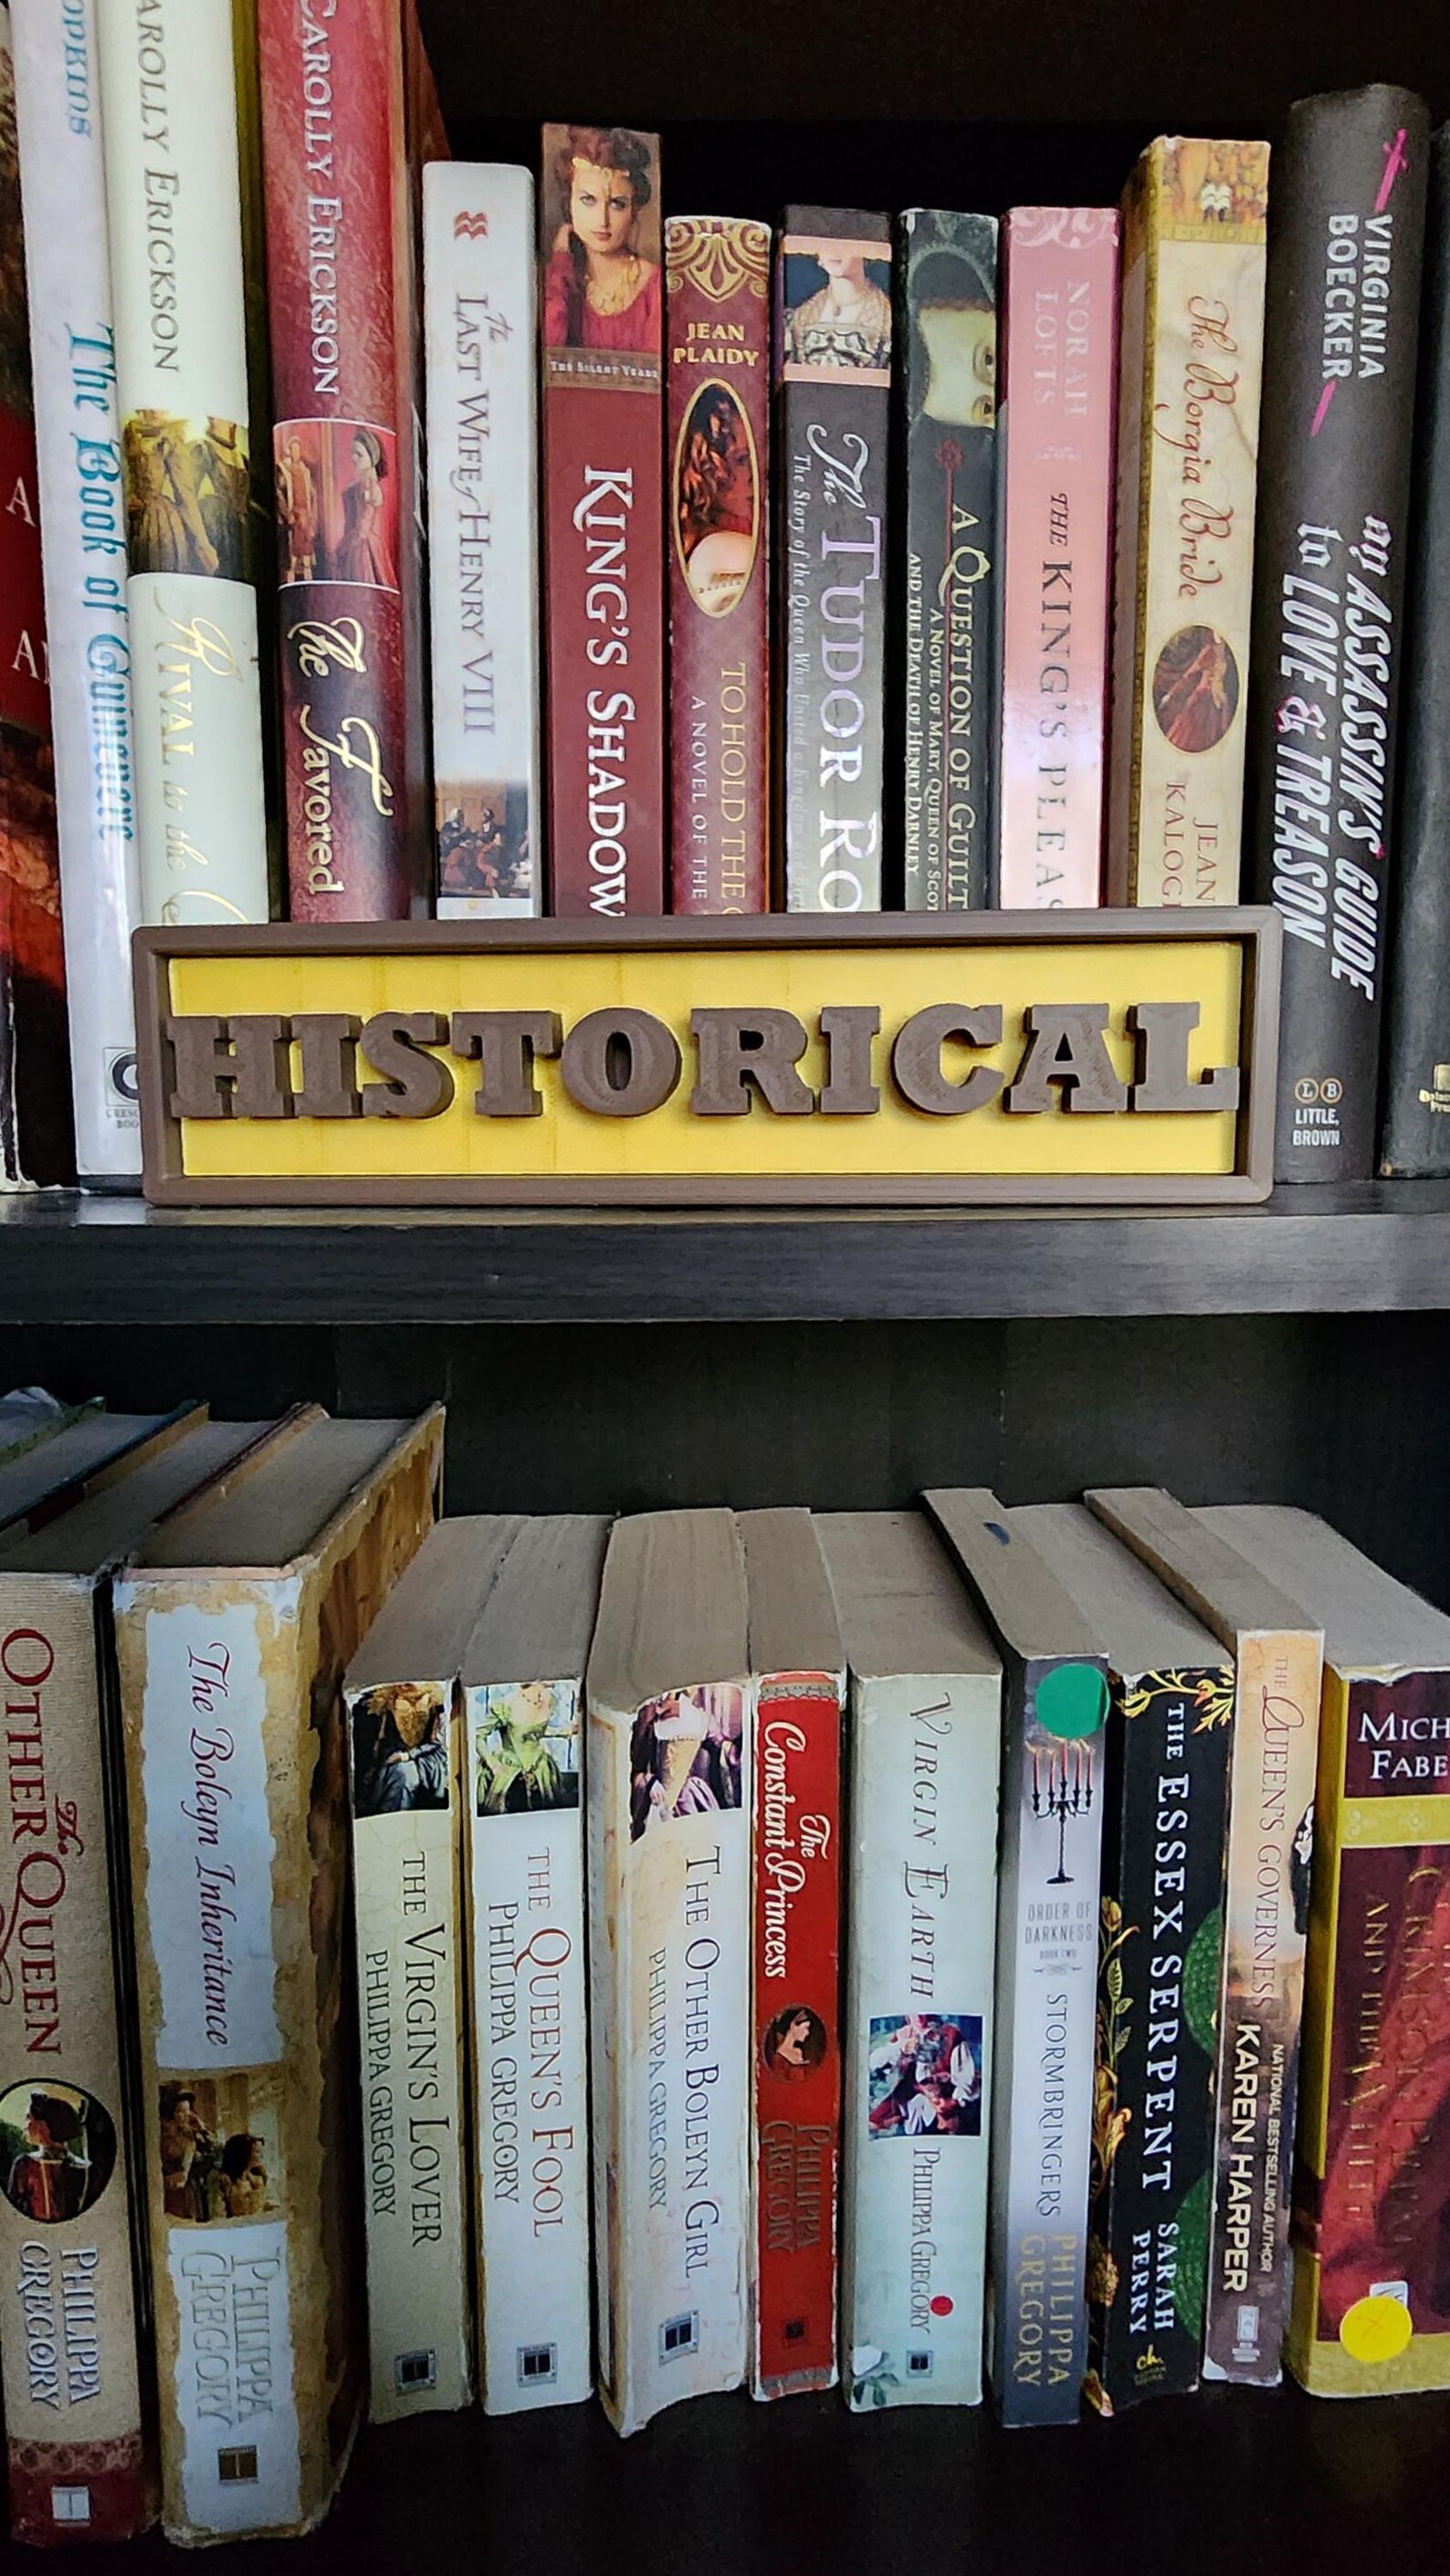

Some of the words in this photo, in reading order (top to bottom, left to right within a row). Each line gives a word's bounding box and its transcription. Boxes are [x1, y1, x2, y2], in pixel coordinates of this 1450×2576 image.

[144, 168, 180, 372] ERICKSON
[306, 196, 343, 394] ERICKSON
[1321, 214, 1361, 381] BOECKER
[1357, 214, 1394, 380] VIRGINIA
[64, 322, 117, 415] The
[454, 293, 489, 382] LAST
[484, 313, 513, 343] The
[673, 347, 760, 368] PLAIDY
[686, 322, 744, 341] JEAN
[1033, 290, 1058, 405] LOFTS
[1066, 280, 1090, 417] NORAH
[1186, 294, 1239, 355] The
[457, 390, 490, 483] WIFE
[792, 454, 813, 482] The
[804, 423, 869, 510] The
[1152, 362, 1240, 486] Borgia
[70, 432, 128, 554] Book
[787, 488, 813, 531] Story
[951, 502, 981, 534] A
[1049, 493, 1068, 548] THE
[1297, 520, 1344, 568] to
[81, 575, 130, 623] of
[458, 508, 491, 638] HENRY
[572, 464, 634, 667] KING'S
[787, 539, 813, 559] of
[791, 561, 811, 587] the
[908, 552, 924, 592] AND
[1176, 497, 1235, 599] Bride
[288, 615, 367, 679] The
[787, 593, 811, 644] Queen
[819, 515, 883, 789] TUDOR
[907, 596, 923, 633] THE
[929, 607, 944, 623] A
[929, 627, 945, 687] NOVEL
[939, 546, 992, 738] QUESTION
[1040, 560, 1073, 738] KING'S
[1279, 573, 1340, 696] LOVE
[153, 584, 247, 765] RIVAL
[462, 650, 495, 735] VIII
[691, 695, 707, 712] A
[720, 663, 747, 712] TO
[907, 635, 923, 697] DEATH
[907, 703, 921, 726] OF
[928, 693, 942, 715] OF
[1336, 573, 1393, 854] ASSASSIN'S
[86, 633, 135, 843] Guinevere
[691, 721, 708, 804] NOVEL
[906, 729, 924, 791] HENRY
[926, 720, 943, 773] MARY,
[1277, 696, 1327, 740] &
[162, 779, 189, 812] to
[299, 704, 394, 895] Favored
[586, 689, 636, 918] SHADOW
[720, 717, 747, 824] HOLD
[924, 777, 943, 838] QUEEN
[949, 749, 972, 791] OF
[164, 823, 210, 871] the
[691, 811, 709, 843] OF
[720, 830, 747, 901] THE
[906, 795, 923, 875] DARNLEY
[927, 843, 940, 865] OF
[947, 803, 976, 910] GUILT
[1192, 818, 1219, 902] JEAN
[1271, 740, 1334, 948] TREASON
[691, 857, 709, 901] THE
[1329, 856, 1380, 1002] GUIDE
[166, 1001, 1240, 1119] HISTORICAL
[1292, 1129, 1340, 1147] BROWN
[1295, 1107, 1340, 1126] LITTLE,
[187, 1642, 233, 1713] The
[1273, 1656, 1289, 1691] THE
[1, 1628, 55, 1844] OTHER
[909, 1691, 954, 1847] VIRGIN
[1165, 1702, 1185, 1761] THE
[1259, 1684, 1306, 1832] QUEEN'S
[1358, 1712, 1450, 1743] MICH
[1369, 1748, 1450, 1780] FABE
[181, 1727, 236, 1847] Boleyn
[763, 1720, 806, 1851] Constant
[402, 1850, 427, 1916] THE
[527, 1847, 552, 1911] THE
[684, 1845, 721, 1927] THE
[798, 1813, 831, 1861] The
[1151, 1774, 1191, 1941] ESSEX
[0, 1850, 66, 2055] QUEEN
[194, 1856, 237, 2047] Inheritance
[763, 1851, 805, 1980] Princess
[901, 1859, 950, 1999] EARTH
[1024, 1923, 1093, 1944] DARKNESS
[1027, 1901, 1070, 1922] ORDER
[1076, 1901, 1092, 1920] OF
[1249, 1840, 1283, 2010] GOVERNESS
[364, 1949, 394, 2081] PHILIPPA
[404, 1922, 447, 2101] VIRGIN'S
[487, 1901, 520, 2047] PHILIPPA
[513, 1926, 573, 2110] QUEEN'S
[646, 1945, 668, 2080] PHILIPPA
[683, 1936, 721, 2060] OTHER
[1037, 1992, 1068, 2218] STORMBRINGERS
[1141, 1952, 1184, 2193] SERPENT
[1231, 2023, 1262, 2145] KAREN
[1266, 2042, 1285, 2117] NATIONAL
[368, 2086, 396, 2216] GREGORY
[489, 2056, 520, 2204] GREGORY
[647, 2081, 668, 2211] GREGORY
[684, 2062, 720, 2192] BOLEYN
[1262, 2118, 1282, 2212] BESTSELLING
[408, 2115, 451, 2247] LOVER
[531, 2124, 575, 2238] FOOL
[758, 2119, 795, 2254] GREGORY
[793, 2123, 831, 2248] PHILIPPA
[912, 2146, 941, 2239] PHILIPPA
[1222, 2152, 1255, 2293] HARPER
[684, 2199, 720, 2279] GIRL
[909, 2238, 937, 2335] GREGORY
[1128, 2228, 1151, 2336] PERRY
[1152, 2221, 1181, 2332] SARAH
[1258, 2211, 1276, 2273] AUTHOR
[17, 2239, 63, 2412] GREGORY
[61, 2246, 100, 2407] PHILIPPA
[181, 2248, 234, 2428] GREGORY
[231, 2246, 282, 2424] PHILIPPA
[1012, 2234, 1045, 2387] GREGORY
[1047, 2234, 1077, 2386] PHILIPPA
